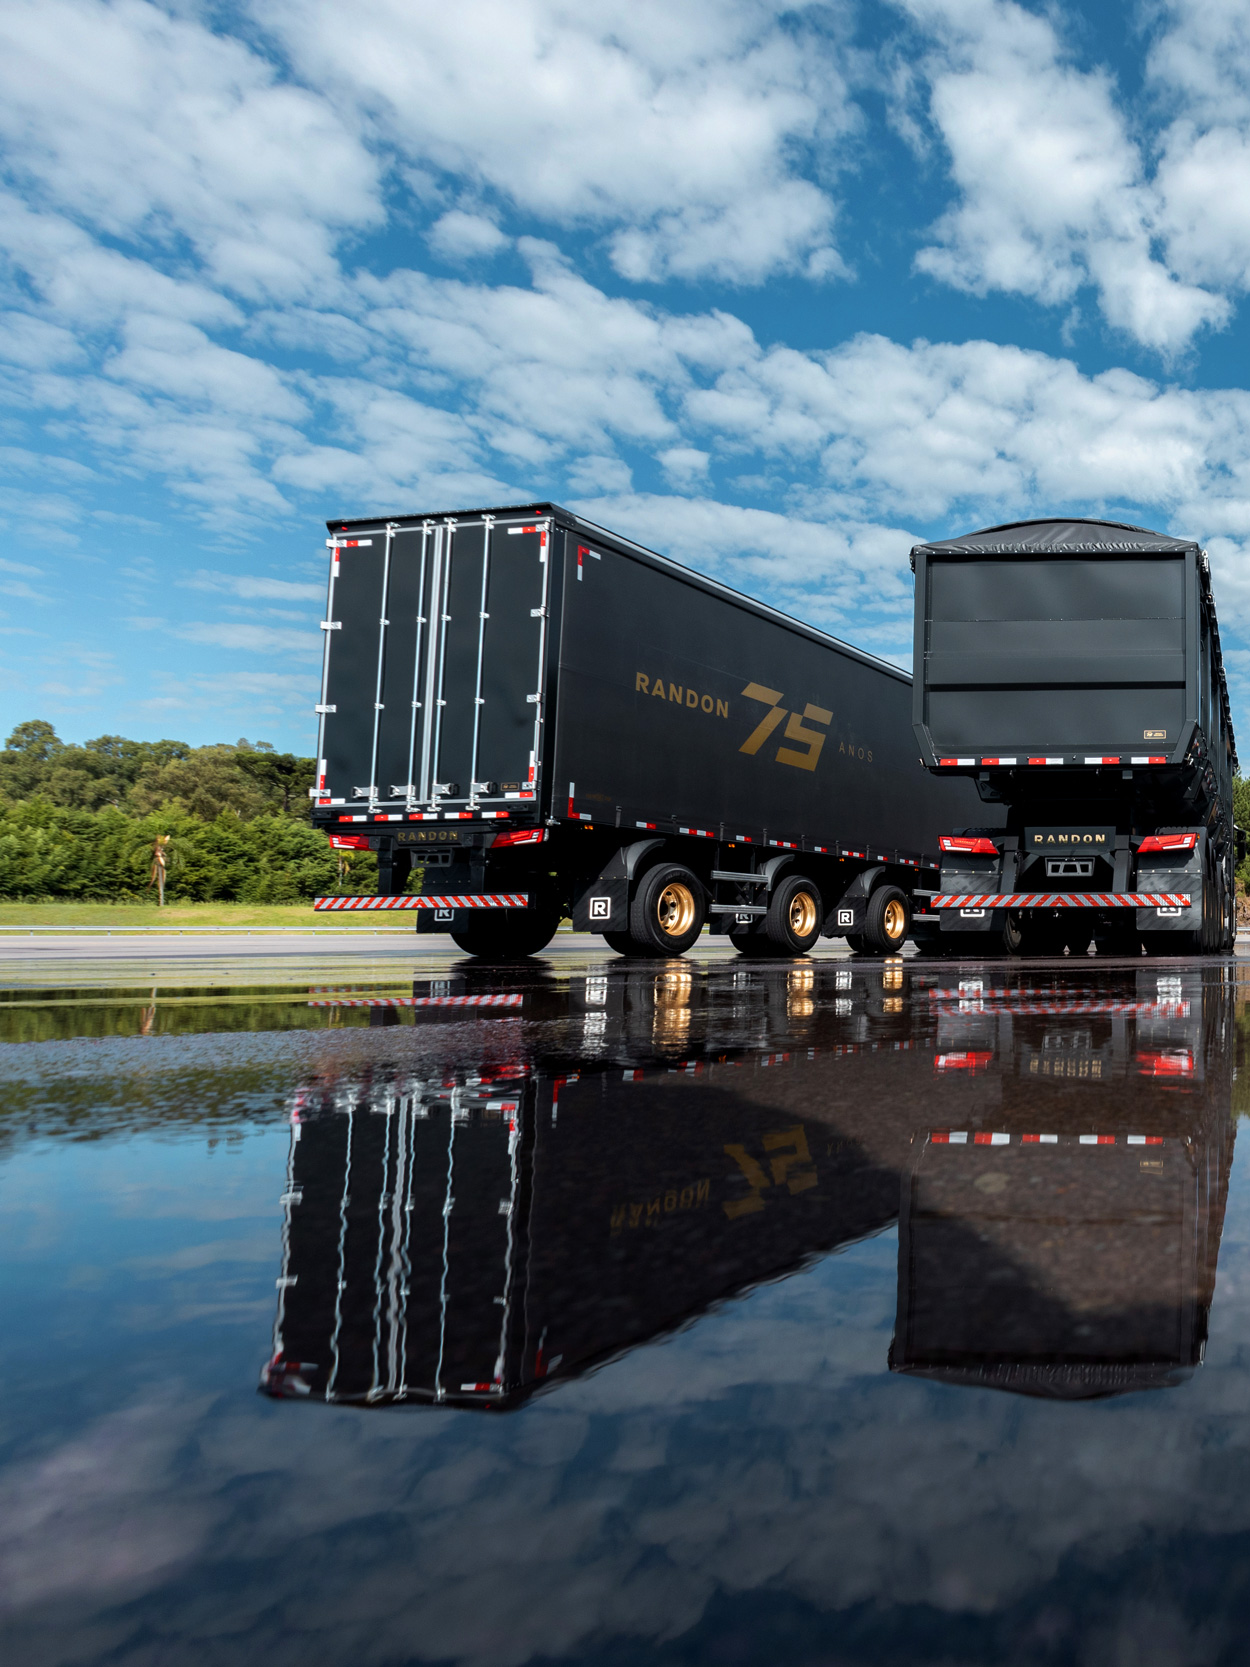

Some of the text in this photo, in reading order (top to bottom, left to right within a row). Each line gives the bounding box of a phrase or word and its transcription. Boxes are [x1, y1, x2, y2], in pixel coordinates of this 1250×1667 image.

[635, 671, 874, 772] RANDON 75 ANOS
[397, 831, 458, 842] RANDON
[1034, 834, 1106, 845] RANDON
